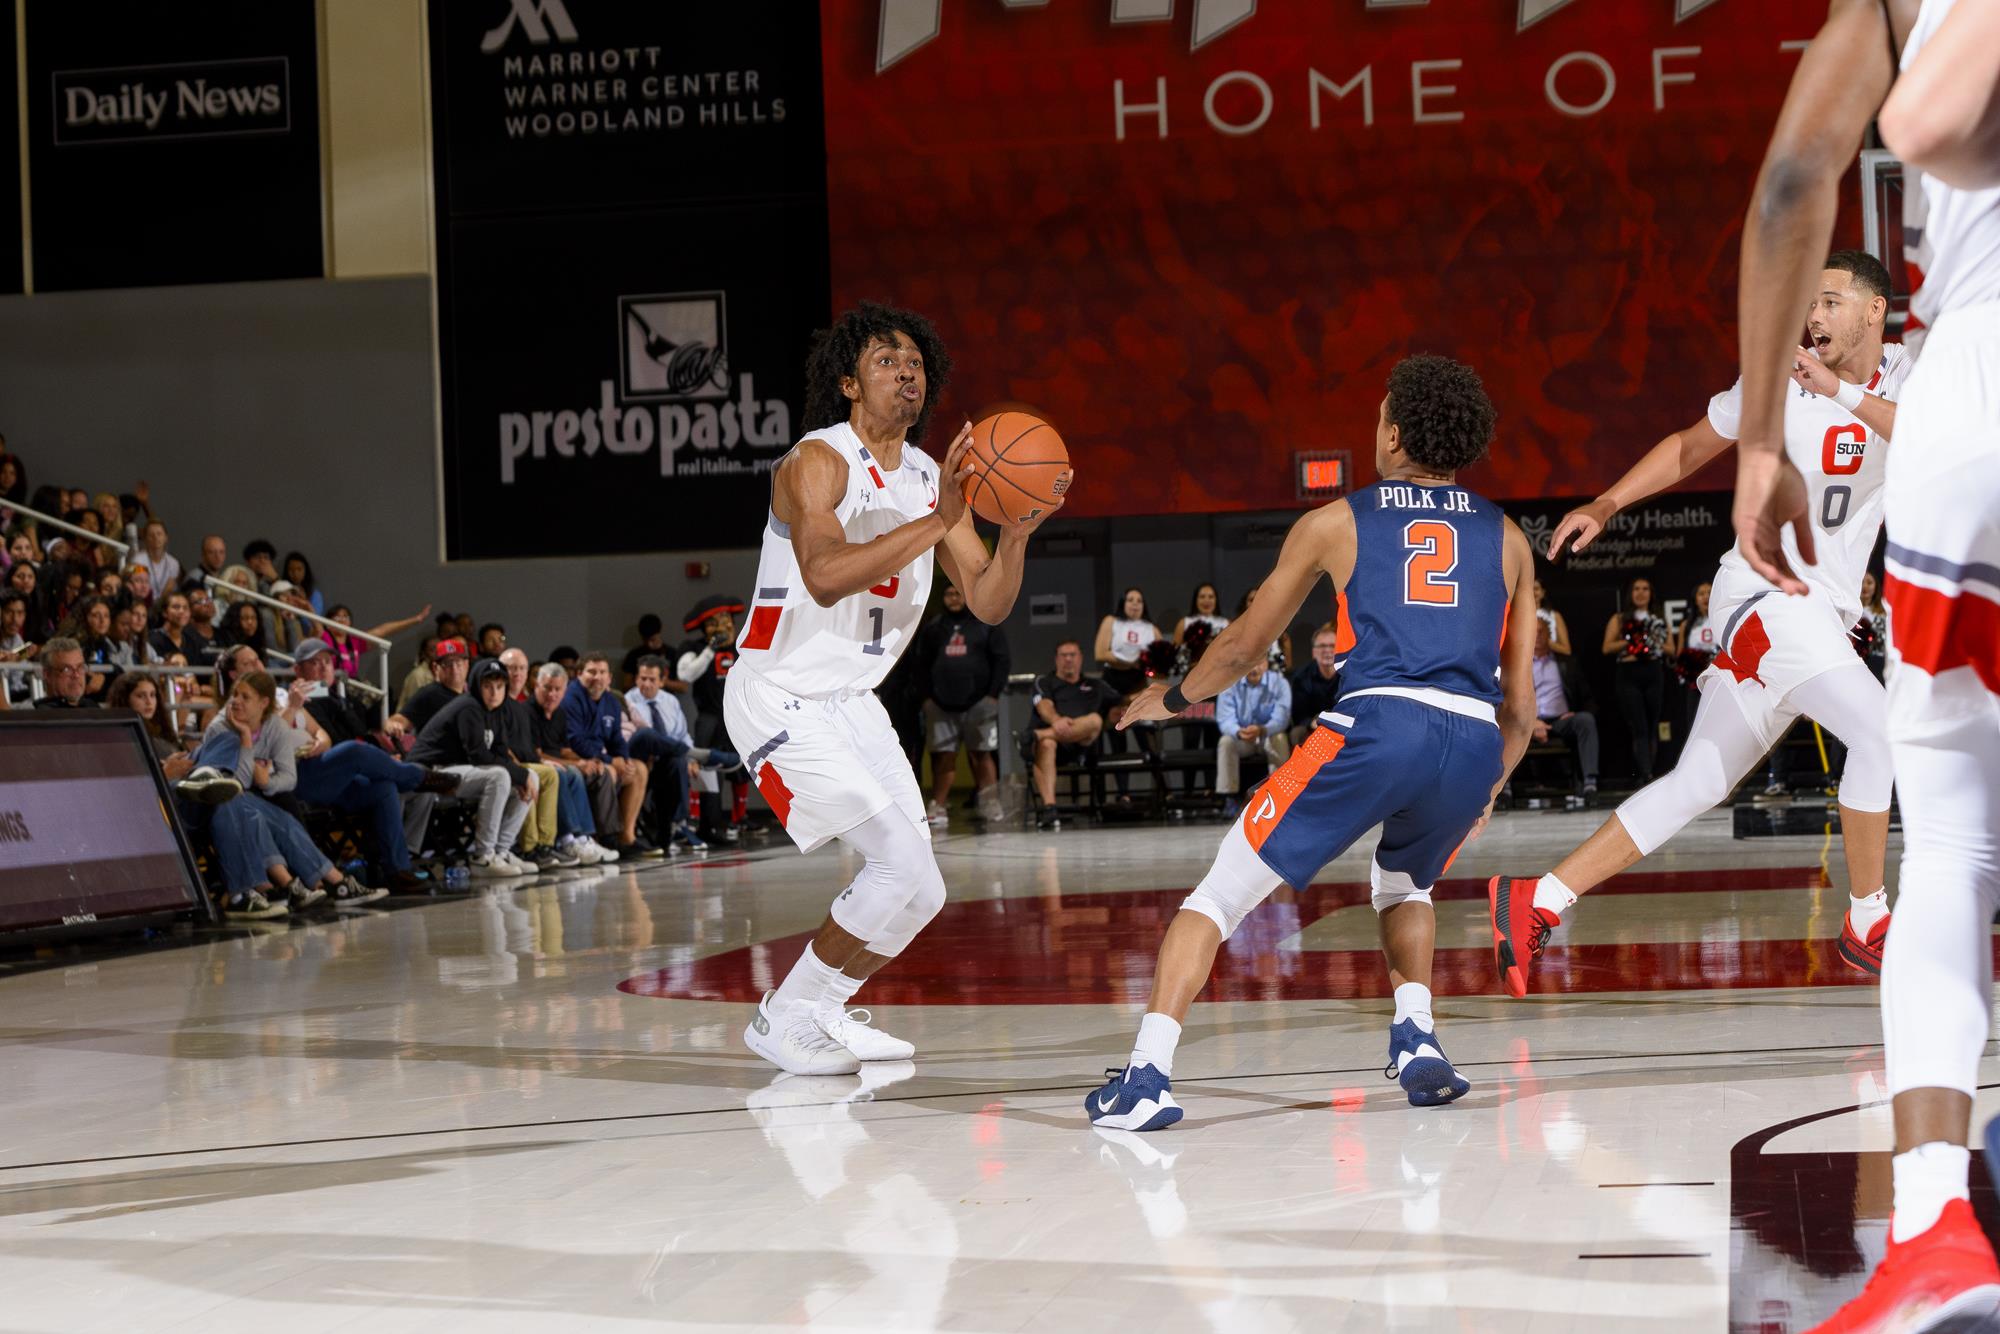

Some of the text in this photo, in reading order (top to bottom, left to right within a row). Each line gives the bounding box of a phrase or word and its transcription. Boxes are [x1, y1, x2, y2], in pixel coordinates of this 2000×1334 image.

[504, 46, 661, 78] MARRIOTT
[65, 79, 281, 130] Daily News
[504, 70, 760, 108] WARNER CENTER
[1113, 46, 1701, 141] HOME OF
[505, 98, 786, 138] WOODLAND HILLS
[677, 458, 700, 475] real
[1837, 443, 1866, 455] SUN
[1379, 486, 1477, 513] POLK JR.
[1822, 485, 1852, 528] 0
[1404, 519, 1459, 607] 2
[1567, 554, 1657, 570] Medical Center
[1634, 536, 1685, 552] Hospital
[862, 607, 886, 656] 1
